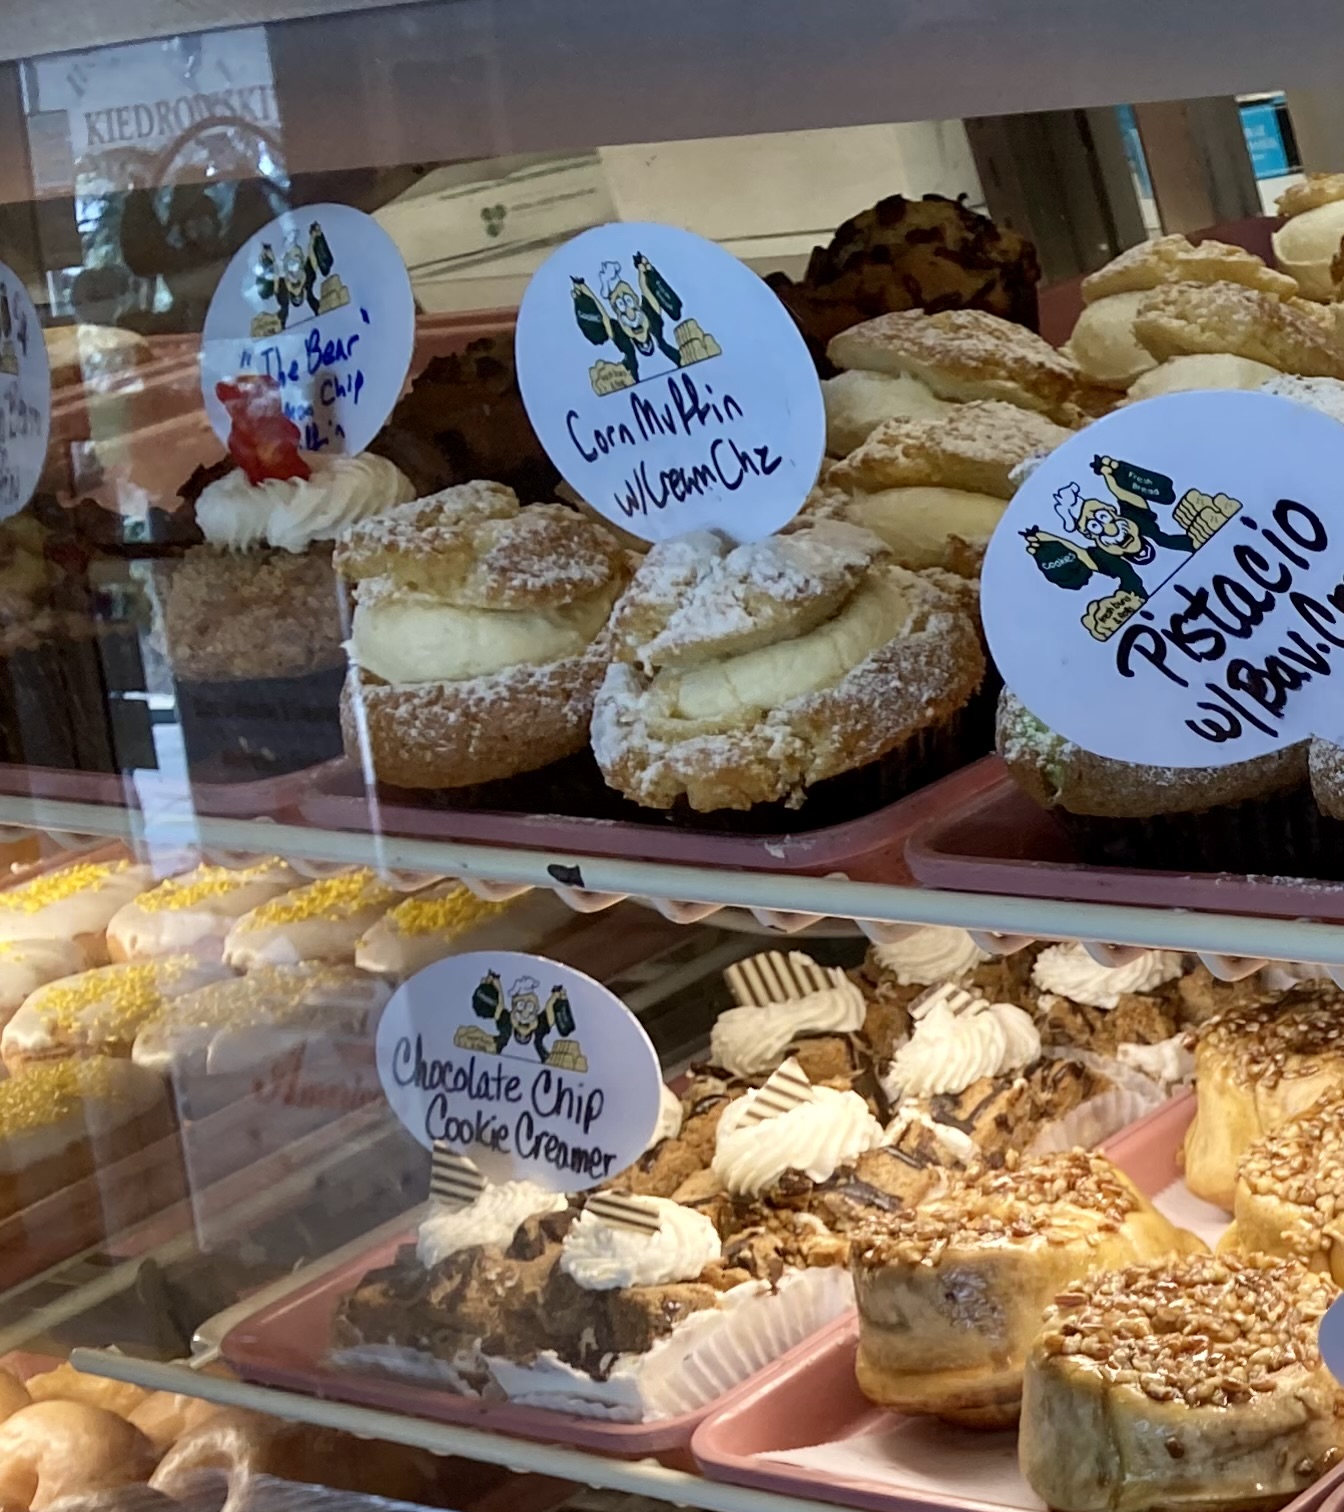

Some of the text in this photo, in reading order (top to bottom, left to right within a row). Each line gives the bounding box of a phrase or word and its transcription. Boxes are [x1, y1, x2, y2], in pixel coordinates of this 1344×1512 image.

[565, 372, 744, 463] Corn Muffin
[1115, 498, 1329, 688] Pistacio
[392, 1032, 605, 1135] Chocolate Chip
[425, 1092, 618, 1180] Cookie Creamer
